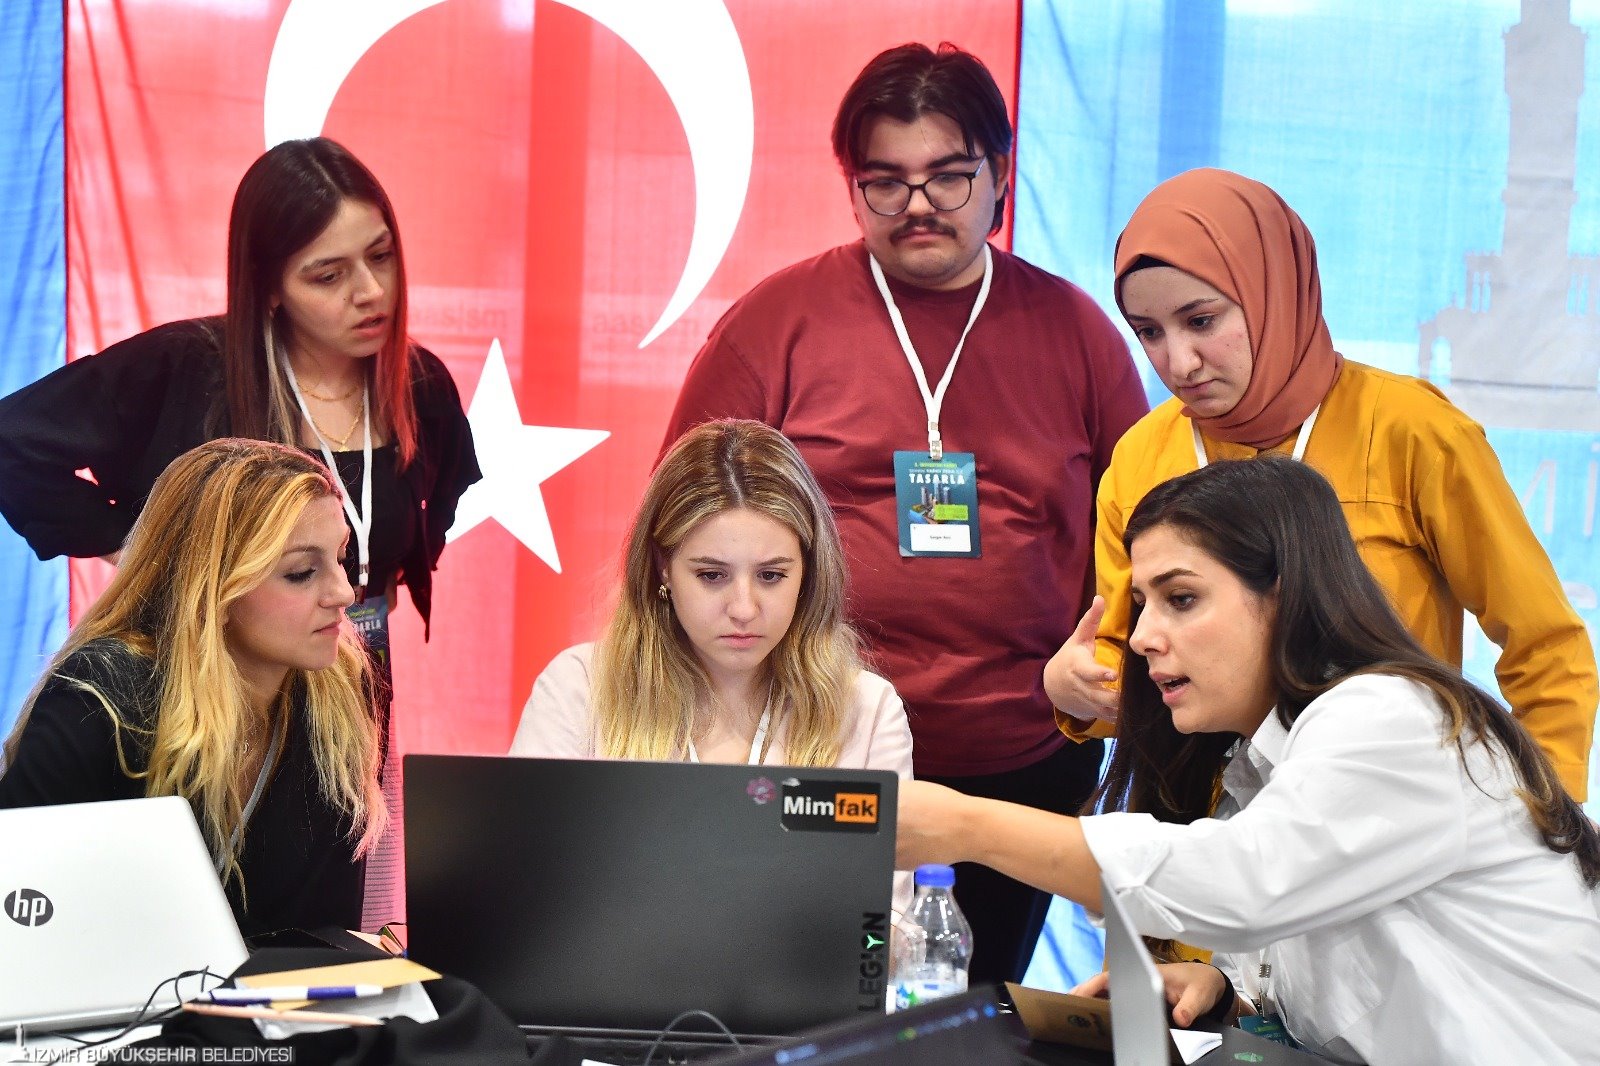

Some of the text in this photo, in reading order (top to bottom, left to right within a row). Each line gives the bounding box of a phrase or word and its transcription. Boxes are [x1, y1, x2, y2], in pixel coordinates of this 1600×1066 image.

[909, 473, 965, 485] TASARLA
[783, 795, 874, 817] Mimfak
[12, 888, 47, 927] hp
[858, 912, 886, 1011] LEGION
